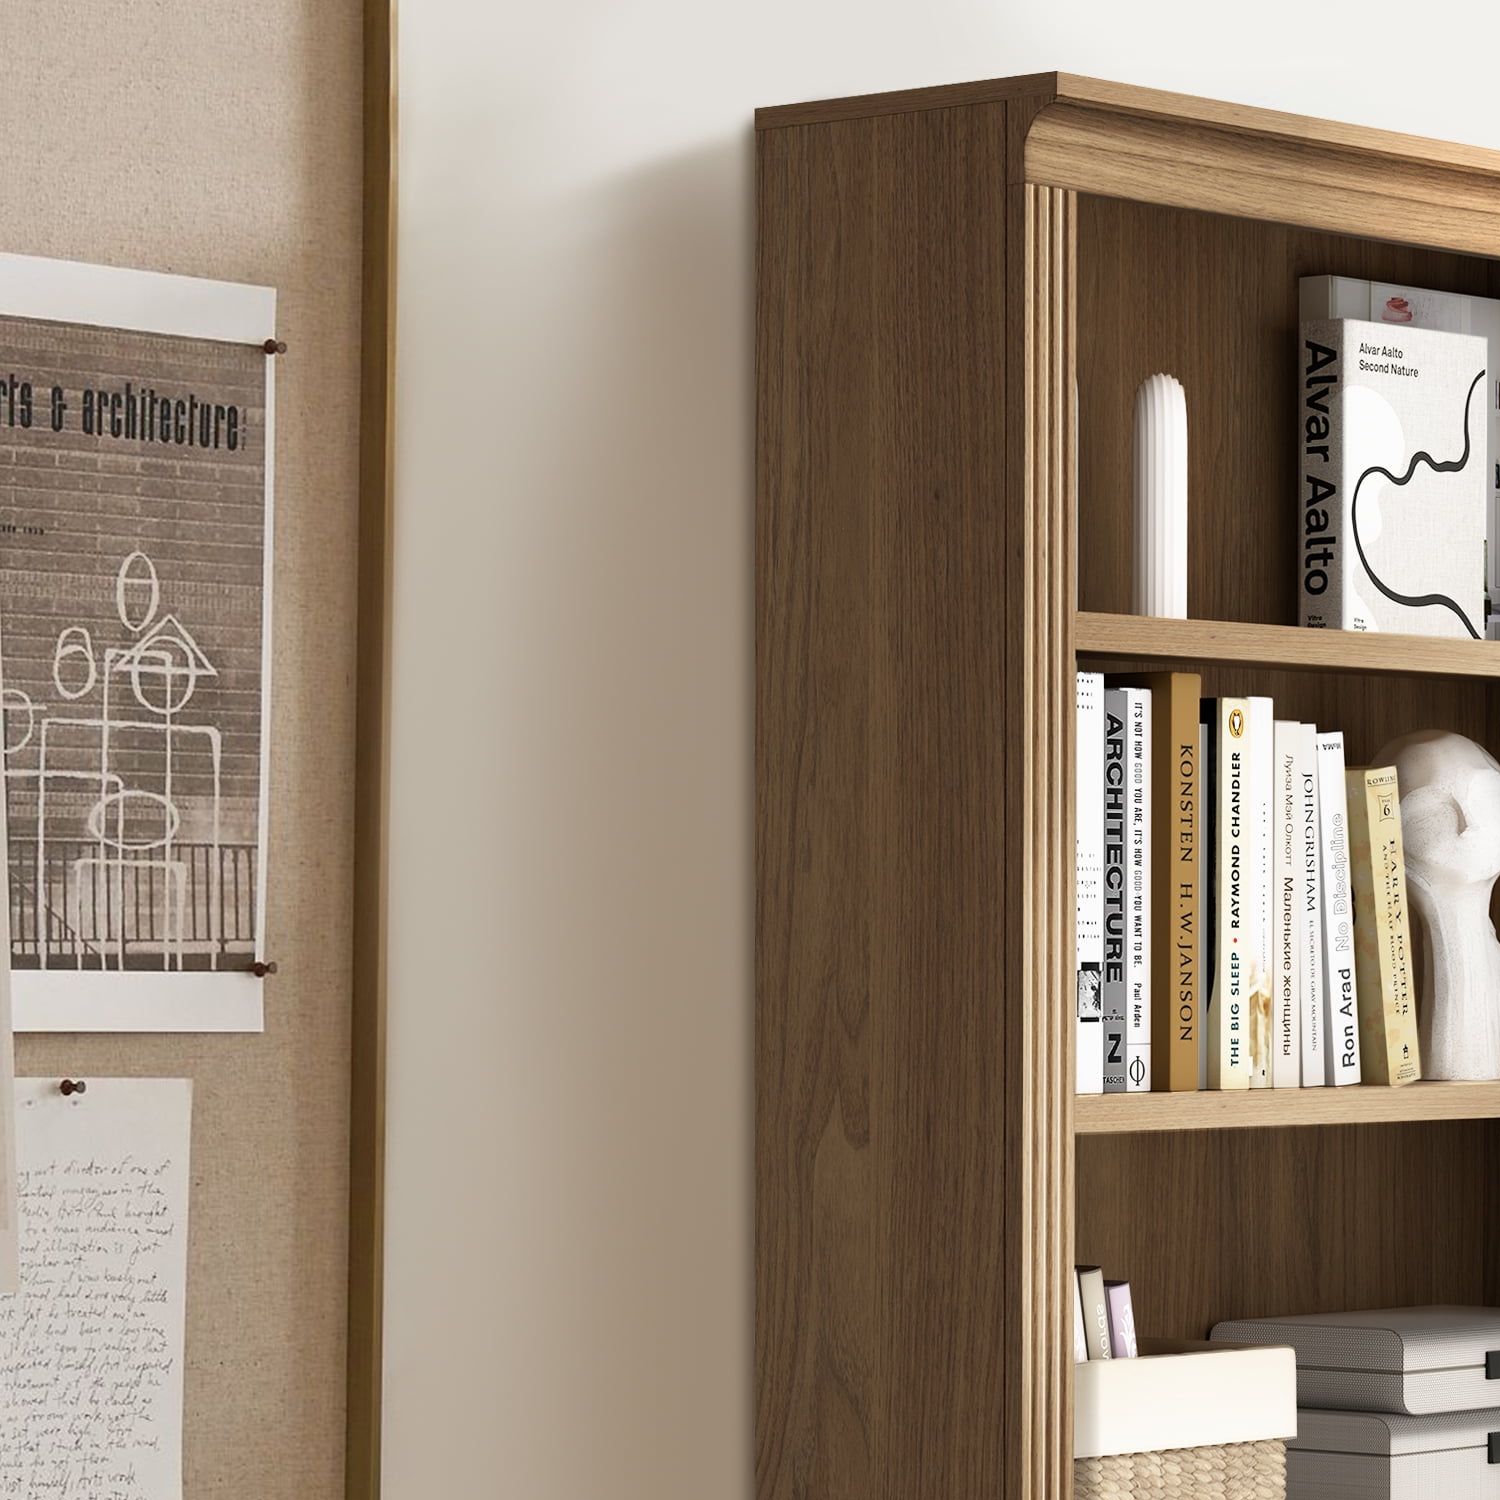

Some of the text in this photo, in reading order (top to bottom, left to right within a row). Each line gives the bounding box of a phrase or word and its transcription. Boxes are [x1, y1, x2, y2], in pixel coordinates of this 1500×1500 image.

[1359, 342, 1403, 359] Alvar Aalto
[1359, 359, 1419, 378] Second Nature
[51, 385, 67, 433] &
[82, 382, 238, 451] architecture
[1304, 340, 1338, 596] Alvar Aalto
[1135, 702, 1143, 718] IT'S
[1134, 721, 1143, 737] NOT
[1134, 740, 1143, 760] HOW
[1134, 763, 1143, 784] GOOD
[1134, 788, 1143, 804] YOU
[1180, 744, 1194, 863] KONSTEN
[1301, 772, 1315, 823] JOHN
[1132, 807, 1143, 826] ARE,
[1383, 804, 1391, 816] 6
[1106, 712, 1124, 983] ARCHITECTURE
[1134, 829, 1143, 846] IT'S
[1134, 847, 1143, 867] HOW
[1304, 826, 1317, 912] GRISHAM
[1330, 813, 1350, 951] No Discipline
[1134, 896, 1143, 911] YOU
[1230, 752, 1241, 1067] THE BIG SLEEP RAYMOND CHANDLER
[1282, 754, 1294, 1056] Луиза Мэй Олкотт Маленькие женщины
[1134, 915, 1143, 938] WANT
[1389, 840, 1408, 1016] HARRY POTTER
[1134, 943, 1143, 952] TO
[1309, 930, 1317, 967] SECRETO
[1133, 955, 1143, 968] BE.
[1134, 982, 1142, 1028] Paul Arden
[1338, 967, 1356, 1068] Ron Arad
